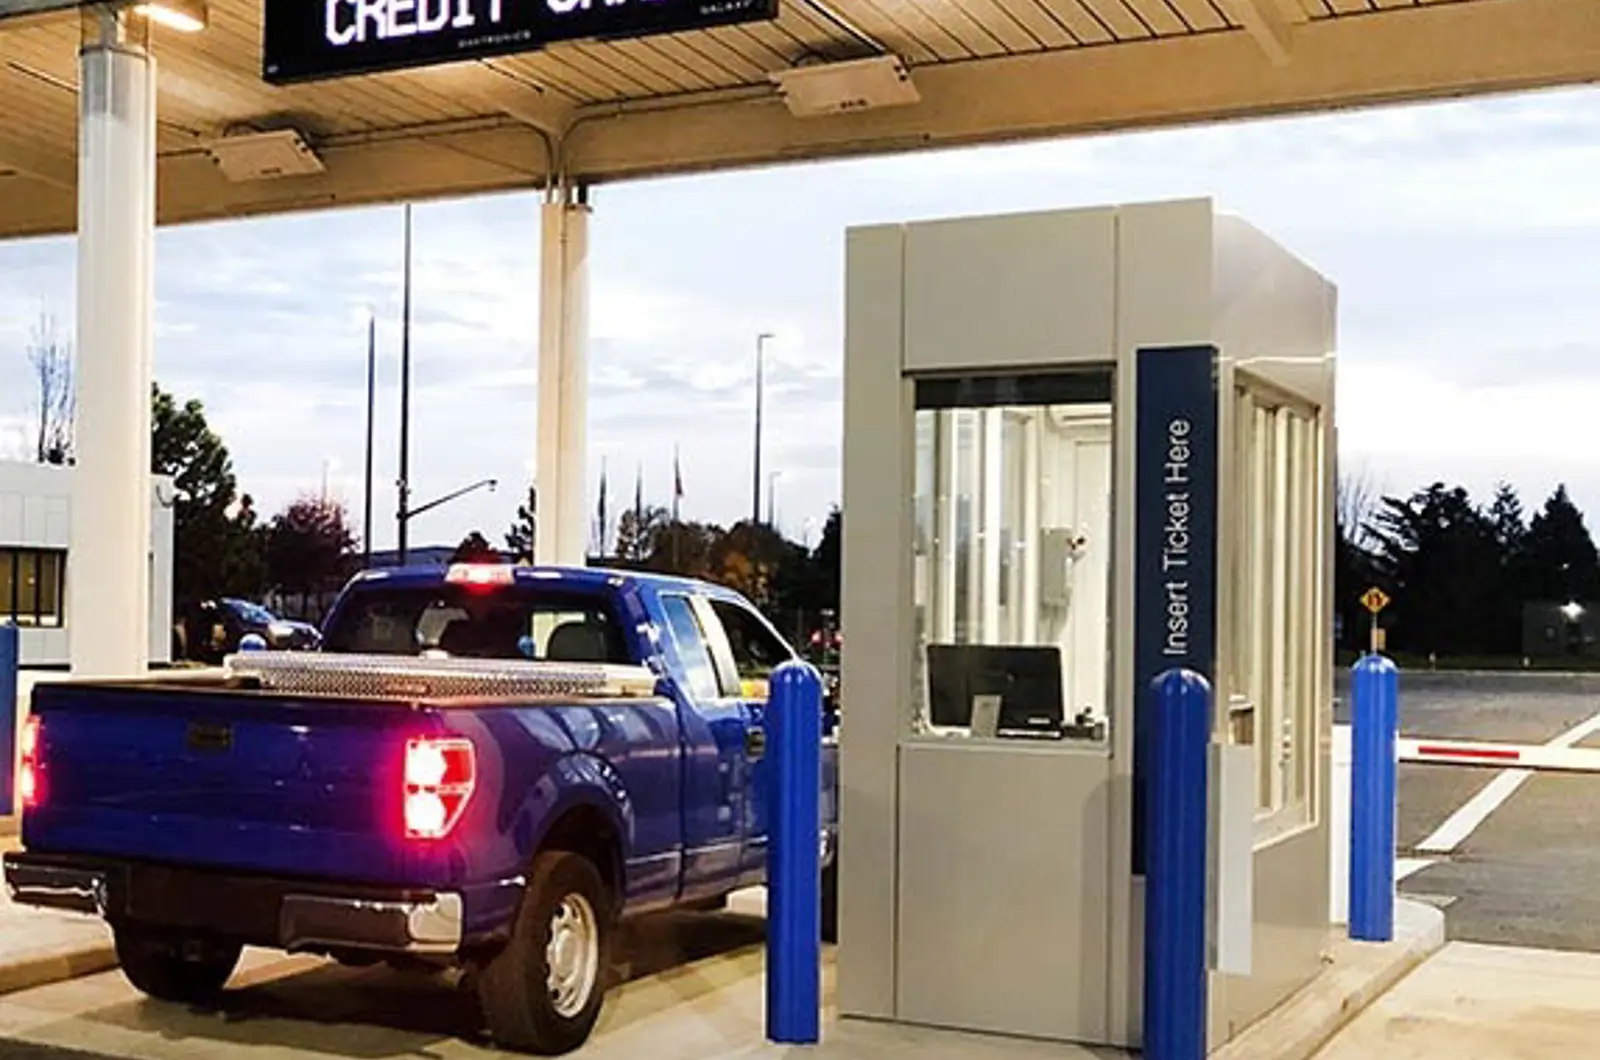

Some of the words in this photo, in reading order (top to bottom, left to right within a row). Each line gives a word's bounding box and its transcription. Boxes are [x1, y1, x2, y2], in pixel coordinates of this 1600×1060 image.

[1164, 418, 1191, 483] Here
[1163, 492, 1190, 572] Ticket
[1163, 581, 1189, 655] Insert
